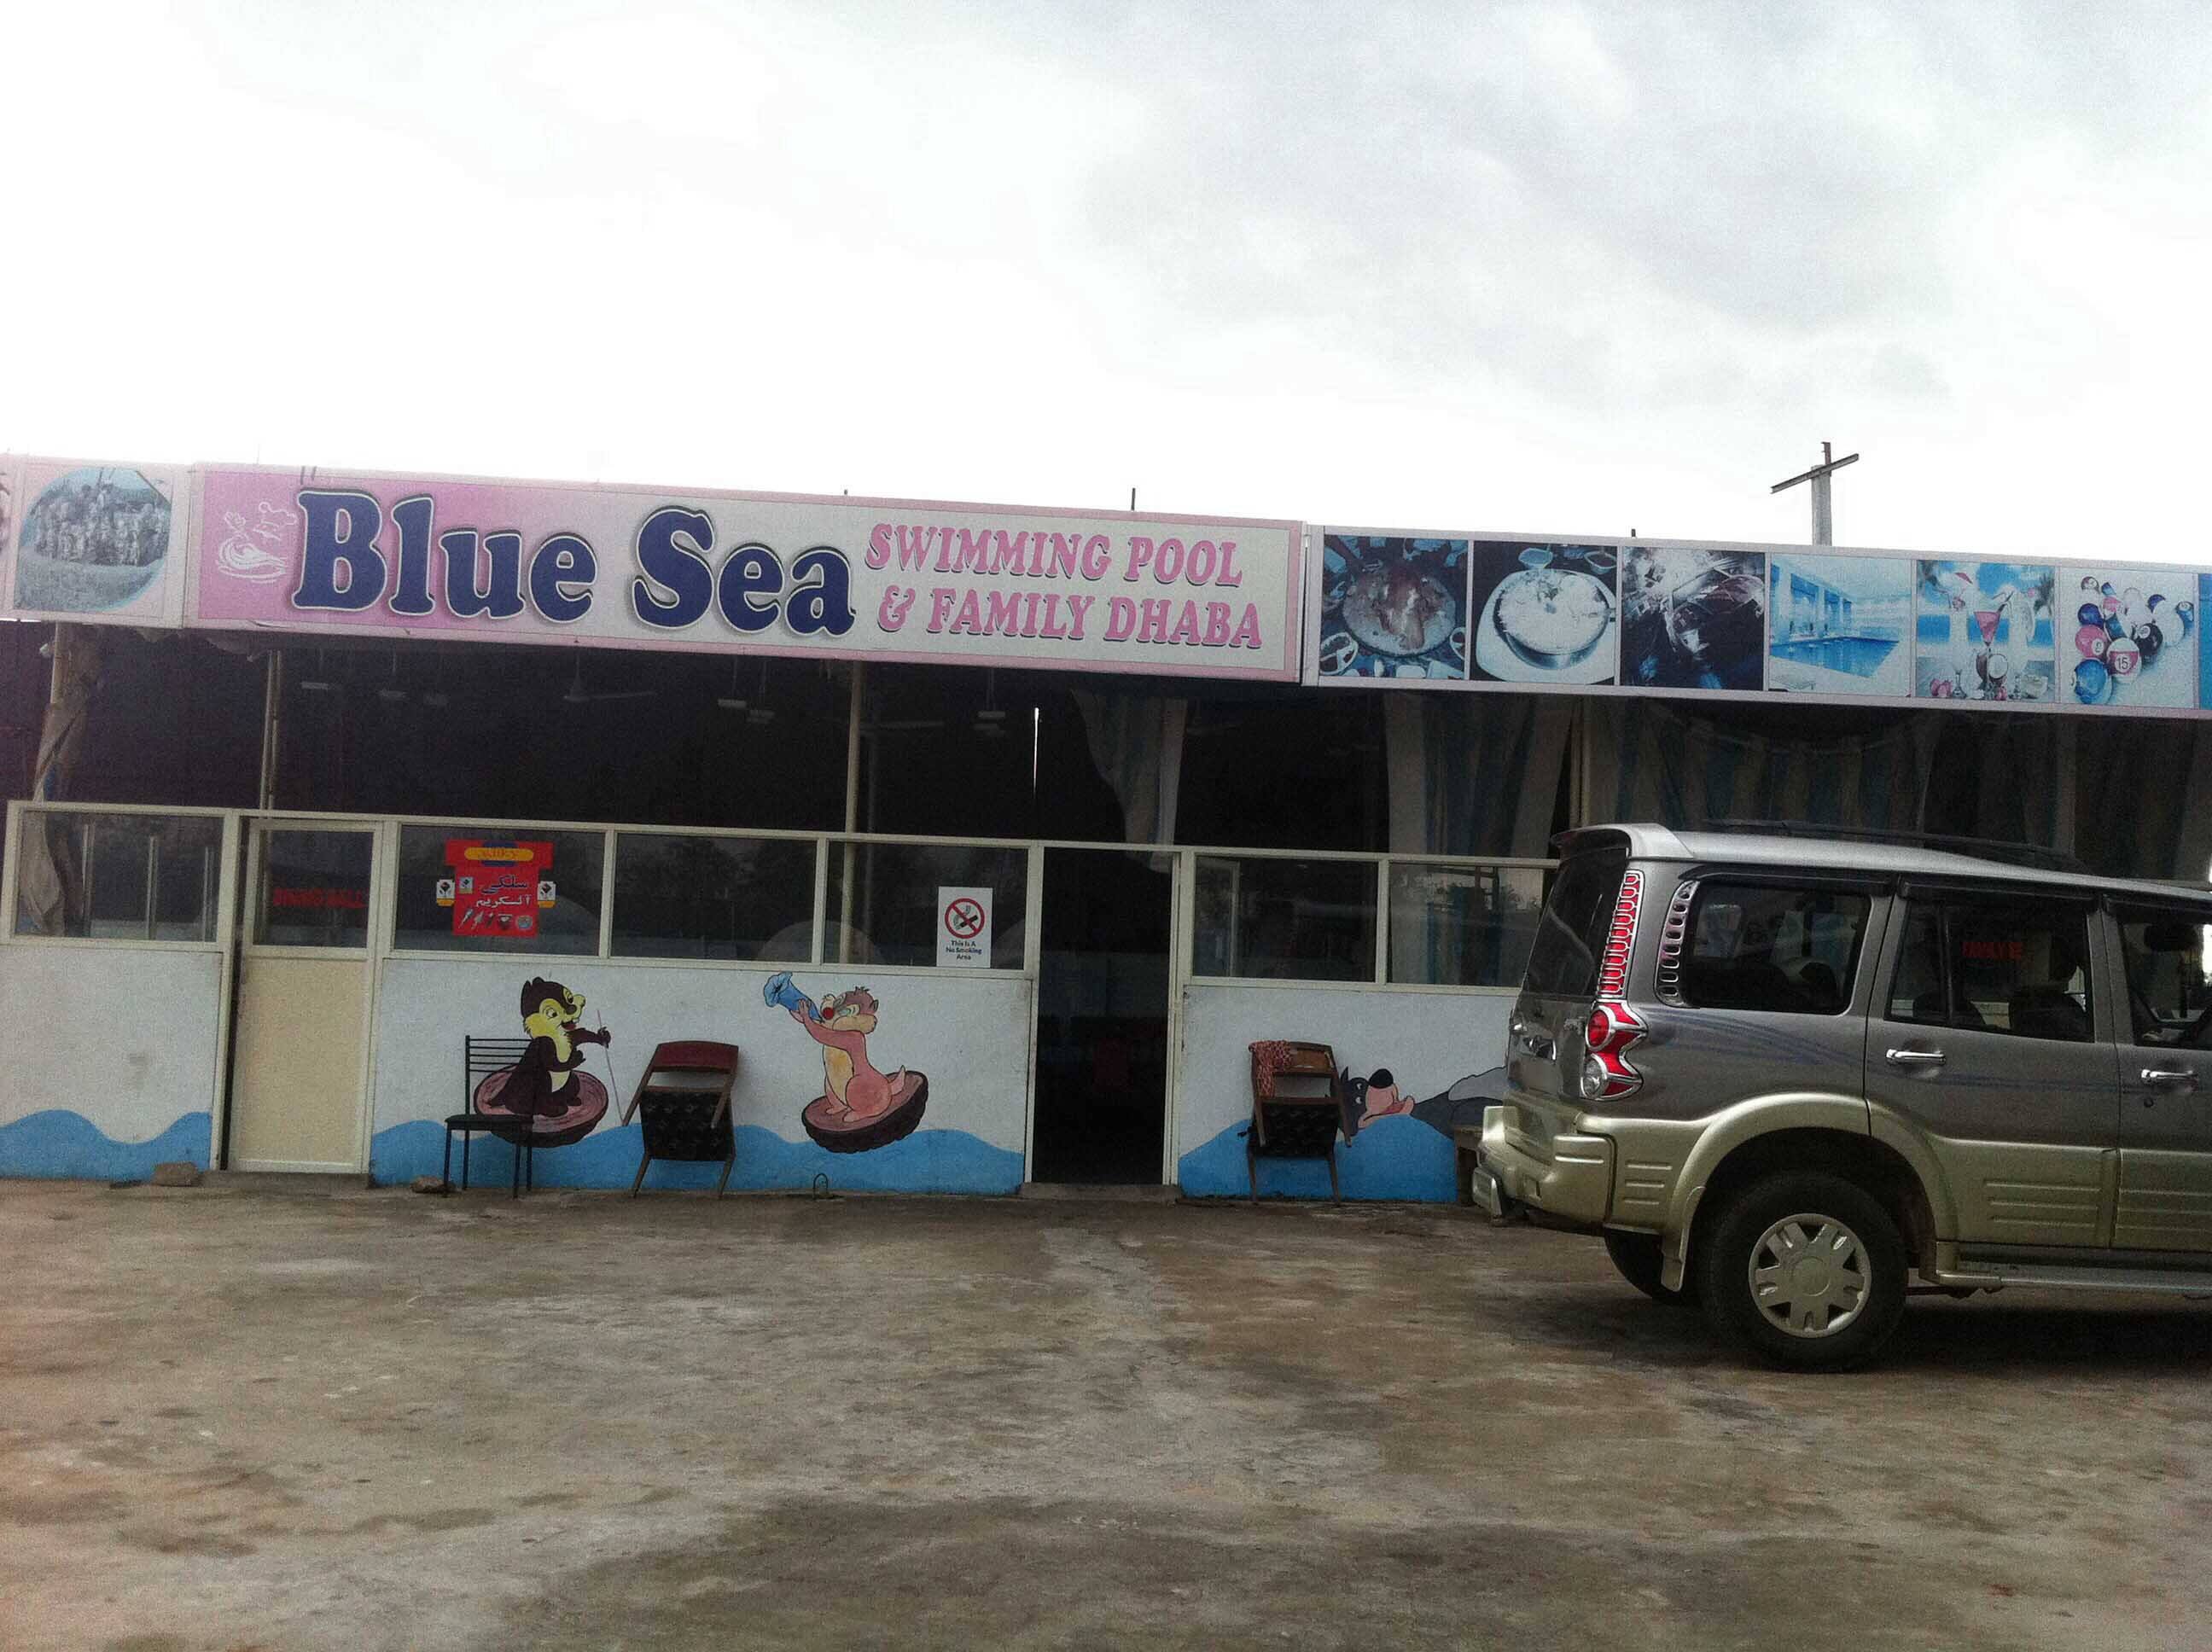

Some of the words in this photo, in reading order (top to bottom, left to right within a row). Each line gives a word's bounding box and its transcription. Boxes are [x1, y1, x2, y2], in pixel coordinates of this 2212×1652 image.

[292, 487, 599, 623] Blue
[632, 504, 858, 637] Sea
[864, 521, 1113, 581] SWIMMING
[1124, 535, 1244, 588] POOL
[877, 584, 917, 632] &
[928, 585, 1097, 641] FAMILY
[1104, 597, 1265, 650] DHABA
[2116, 657, 2129, 671] 15
